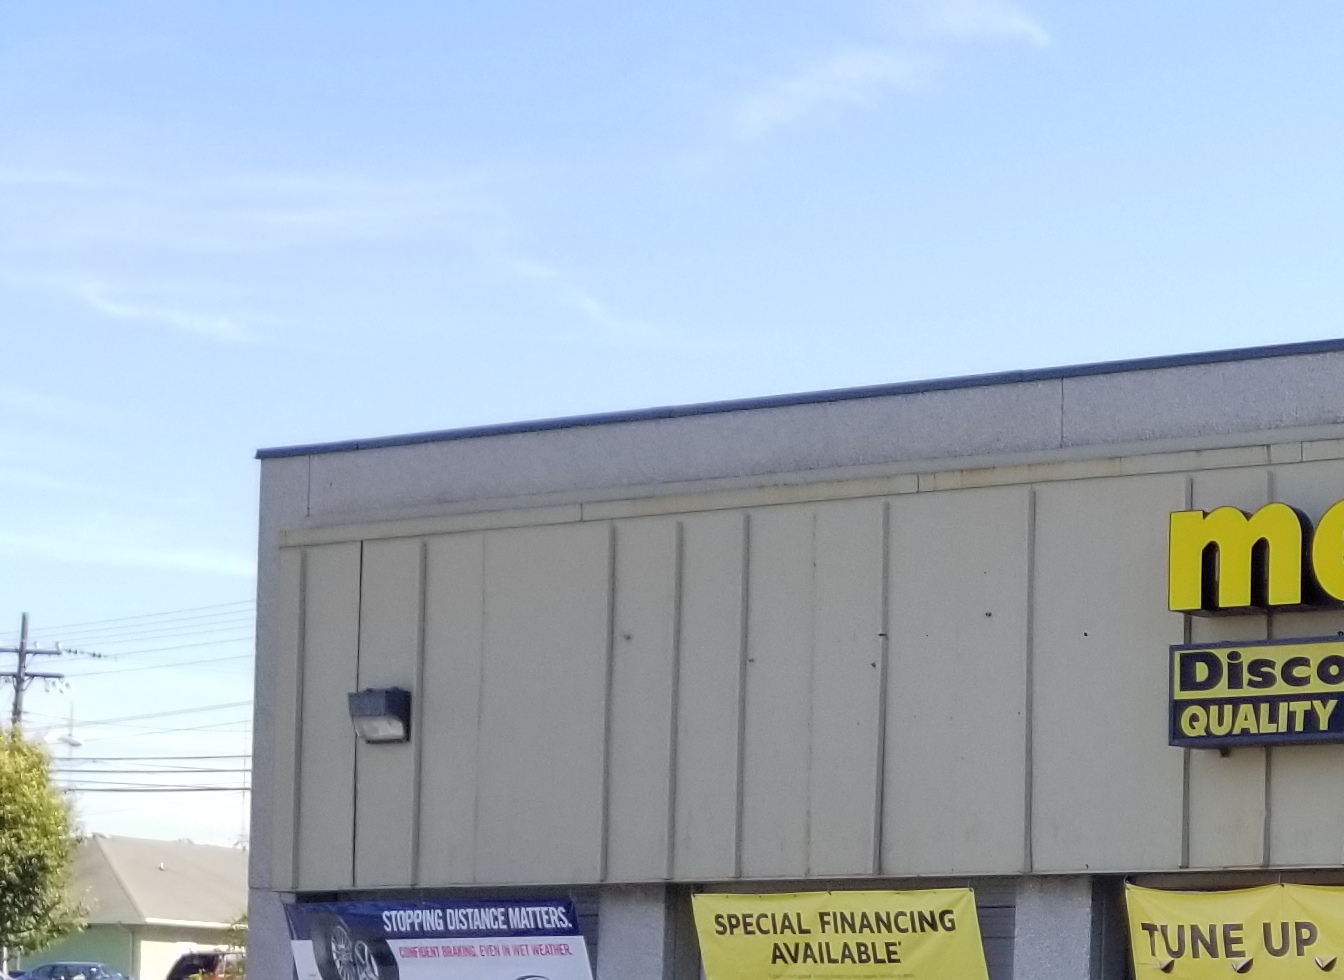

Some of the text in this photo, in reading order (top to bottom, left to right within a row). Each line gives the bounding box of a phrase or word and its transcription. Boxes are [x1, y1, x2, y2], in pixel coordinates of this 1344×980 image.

[1180, 699, 1338, 737] QUALITY
[382, 906, 573, 932] STOPPING DISTANCE MATTERS.
[714, 908, 956, 936] SPECIAL FINANCING
[480, 944, 500, 957] EVEN
[513, 944, 529, 957] WET
[1140, 920, 1318, 960] TUNE UP
